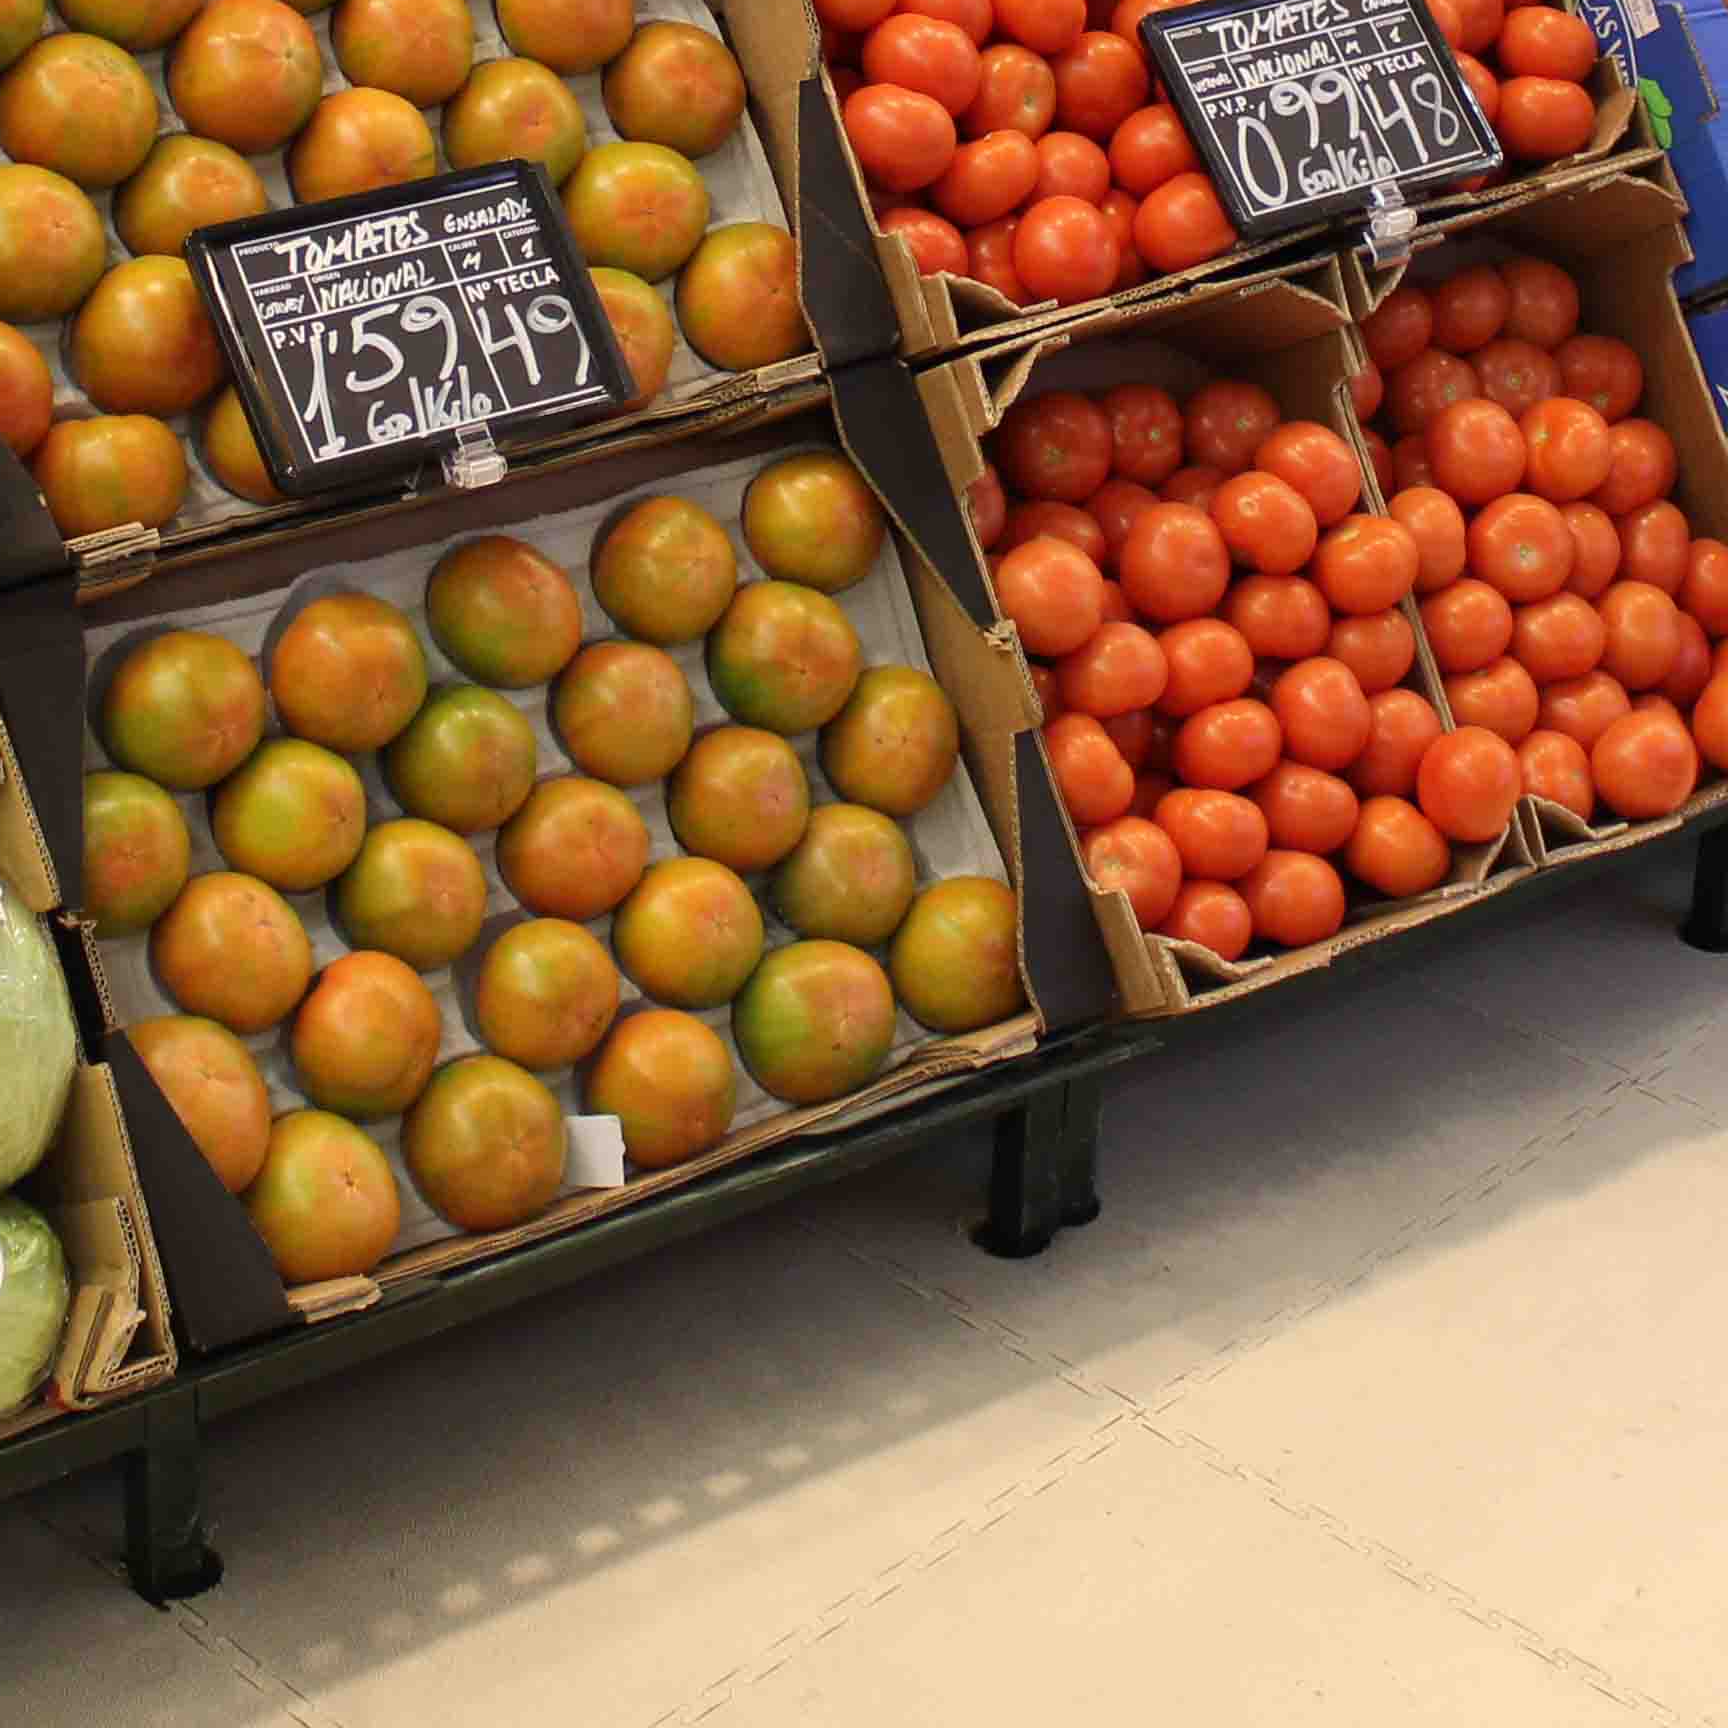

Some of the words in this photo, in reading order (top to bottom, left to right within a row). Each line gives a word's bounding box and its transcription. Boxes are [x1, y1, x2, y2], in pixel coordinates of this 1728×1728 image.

[1238, 40, 1337, 88] NACIONAL
[1374, 51, 1426, 77] TECLA
[1205, 97, 1254, 120] P.V.P.
[1366, 72, 1460, 164] 48
[273, 211, 430, 274] TOMATES
[254, 283, 292, 297] VARIEDAD
[318, 259, 435, 311] NACIONAL
[495, 268, 561, 297] TECLA
[478, 295, 591, 386] 49
